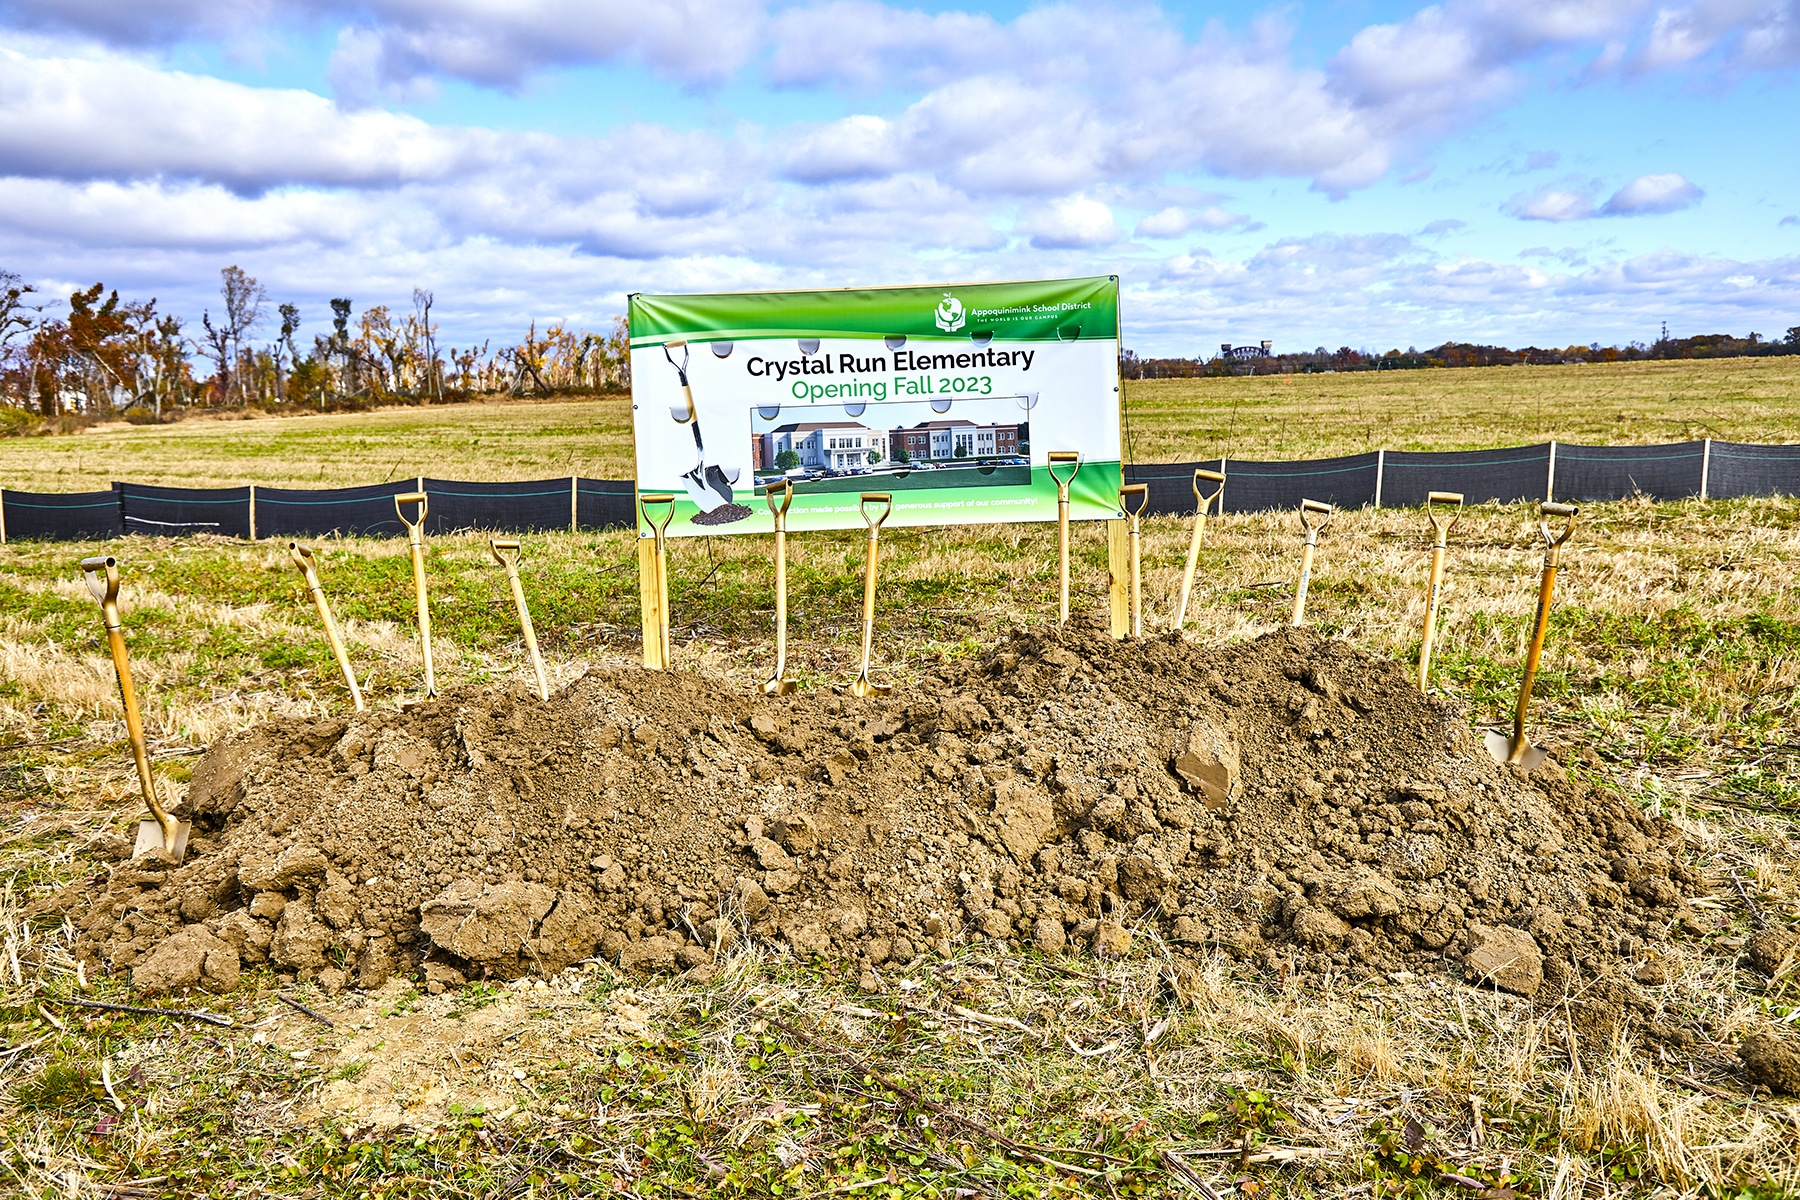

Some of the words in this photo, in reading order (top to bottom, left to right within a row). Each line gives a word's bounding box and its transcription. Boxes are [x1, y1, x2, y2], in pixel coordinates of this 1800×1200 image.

[971, 305, 1031, 316] Appoquinimink
[1033, 303, 1060, 313] School
[1062, 301, 1091, 311] District
[747, 354, 833, 382] Crystal
[840, 353, 886, 374] Run
[893, 348, 1035, 372] Elementary
[791, 378, 887, 403] Opening
[894, 375, 933, 396] Fall
[939, 376, 992, 395] 2023
[810, 504, 832, 514] made
[834, 503, 868, 514] possibe
[868, 503, 879, 512] by
[895, 502, 932, 511] generous
[933, 500, 965, 509] support
[966, 498, 975, 507] of
[976, 499, 989, 507] our
[990, 497, 1038, 506] community!
